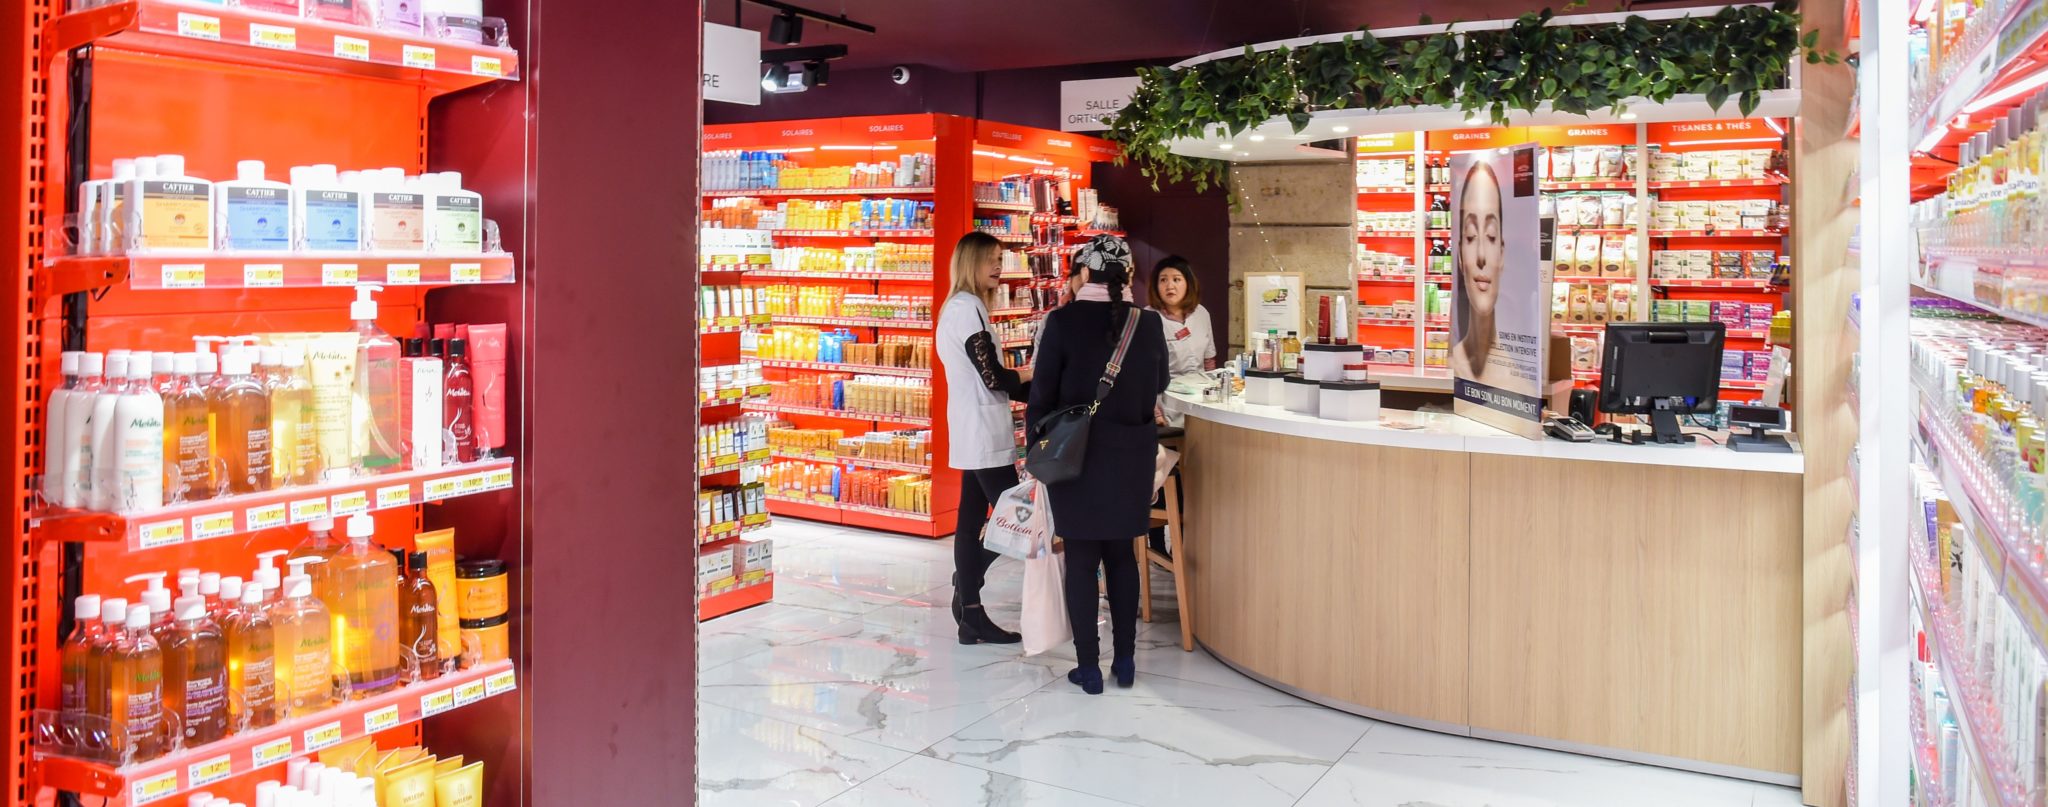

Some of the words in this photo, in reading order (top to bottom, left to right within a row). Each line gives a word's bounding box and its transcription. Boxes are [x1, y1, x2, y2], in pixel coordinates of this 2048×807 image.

[1085, 99, 1119, 111] SALLE
[868, 124, 904, 133] SOLAIRES
[1672, 123, 1713, 132] TISANES
[703, 132, 733, 140] SOLAIRES
[782, 129, 814, 137] SOLAIRES
[1452, 132, 1491, 140] GRAINES
[1568, 128, 1609, 137] GRAINES
[162, 182, 195, 192] CATTIER
[245, 188, 276, 197] CATTIER
[321, 191, 348, 200] CATTIER
[388, 194, 413, 202] CATTIER
[1464, 385, 1472, 397] LE
[1471, 387, 1481, 400] BON
[1493, 394, 1501, 405] AU
[1501, 396, 1512, 408] BON
[1512, 399, 1537, 415] MOMENT.
[996, 516, 1044, 539] Boticinl
